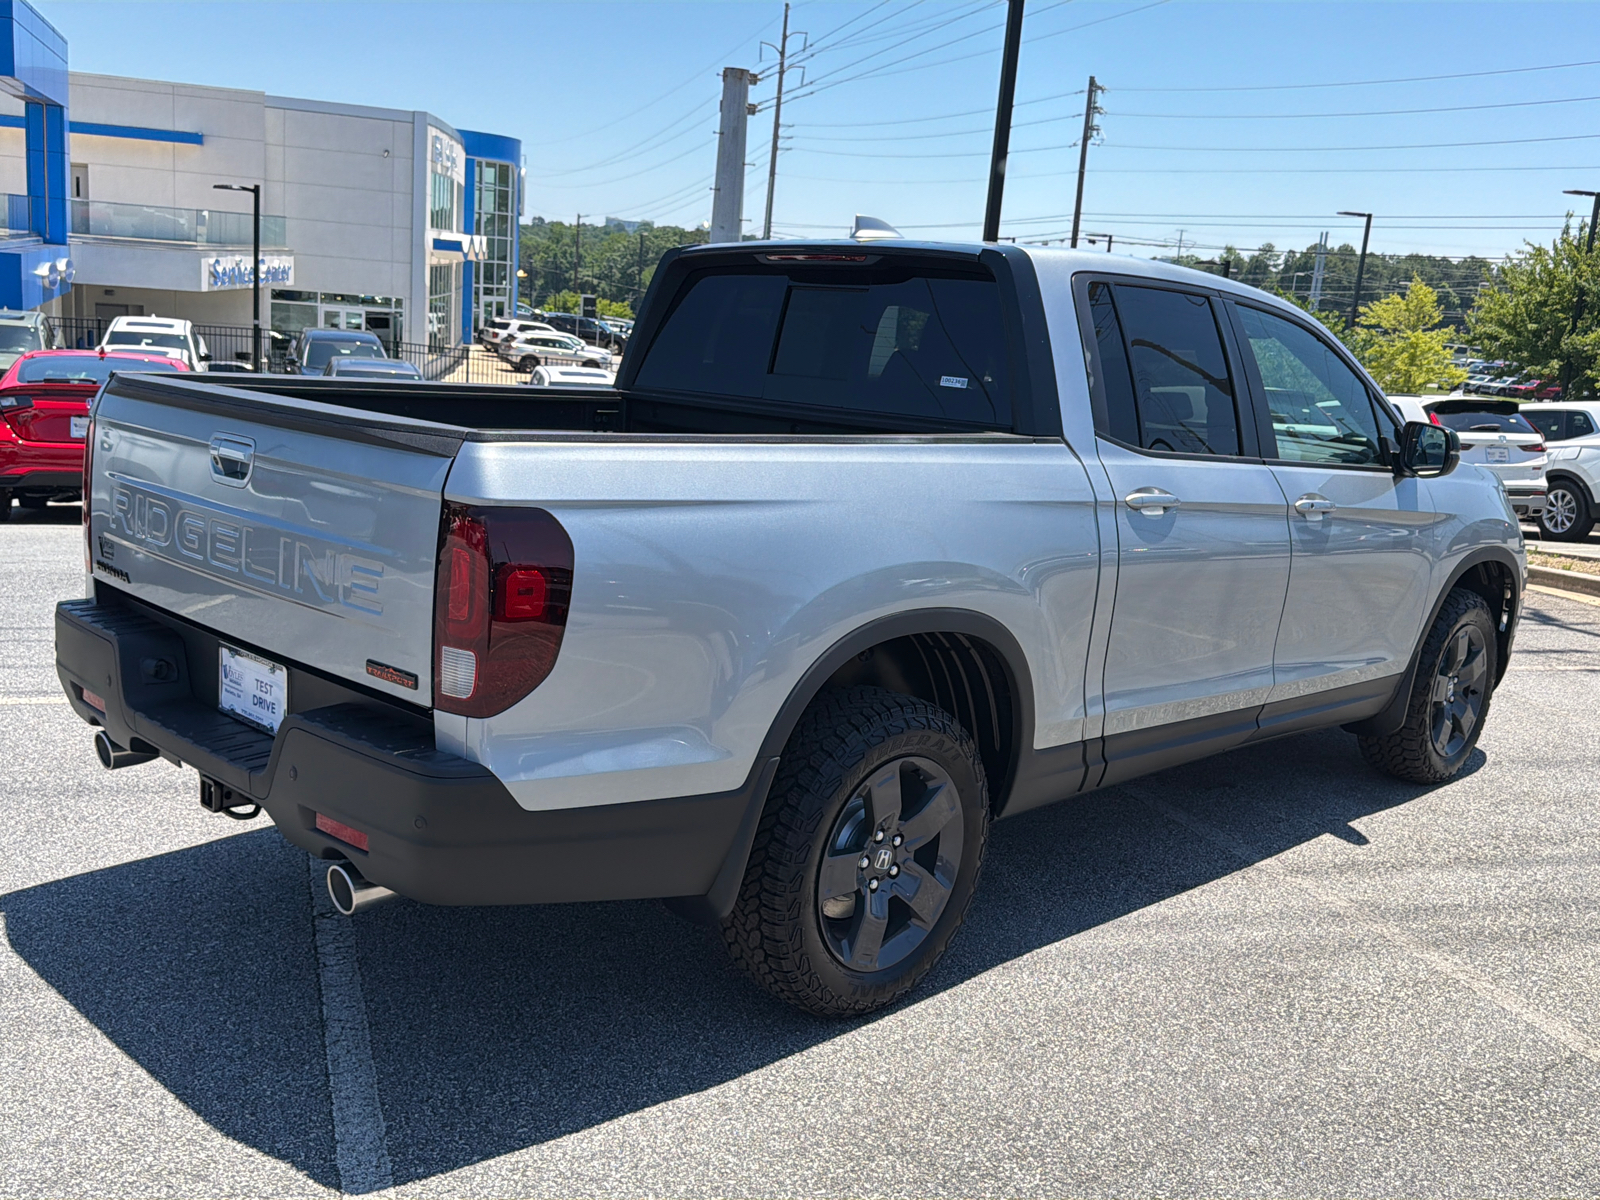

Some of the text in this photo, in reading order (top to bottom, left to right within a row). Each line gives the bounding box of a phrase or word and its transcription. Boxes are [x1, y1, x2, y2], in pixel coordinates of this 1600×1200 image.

[210, 258, 292, 287] Service Center
[109, 485, 384, 616] RIDGELINE
[254, 678, 274, 697] TEST
[366, 666, 414, 687] TRAILSPORT
[252, 693, 276, 715] DRIVE
[836, 734, 932, 802] GRABBER
